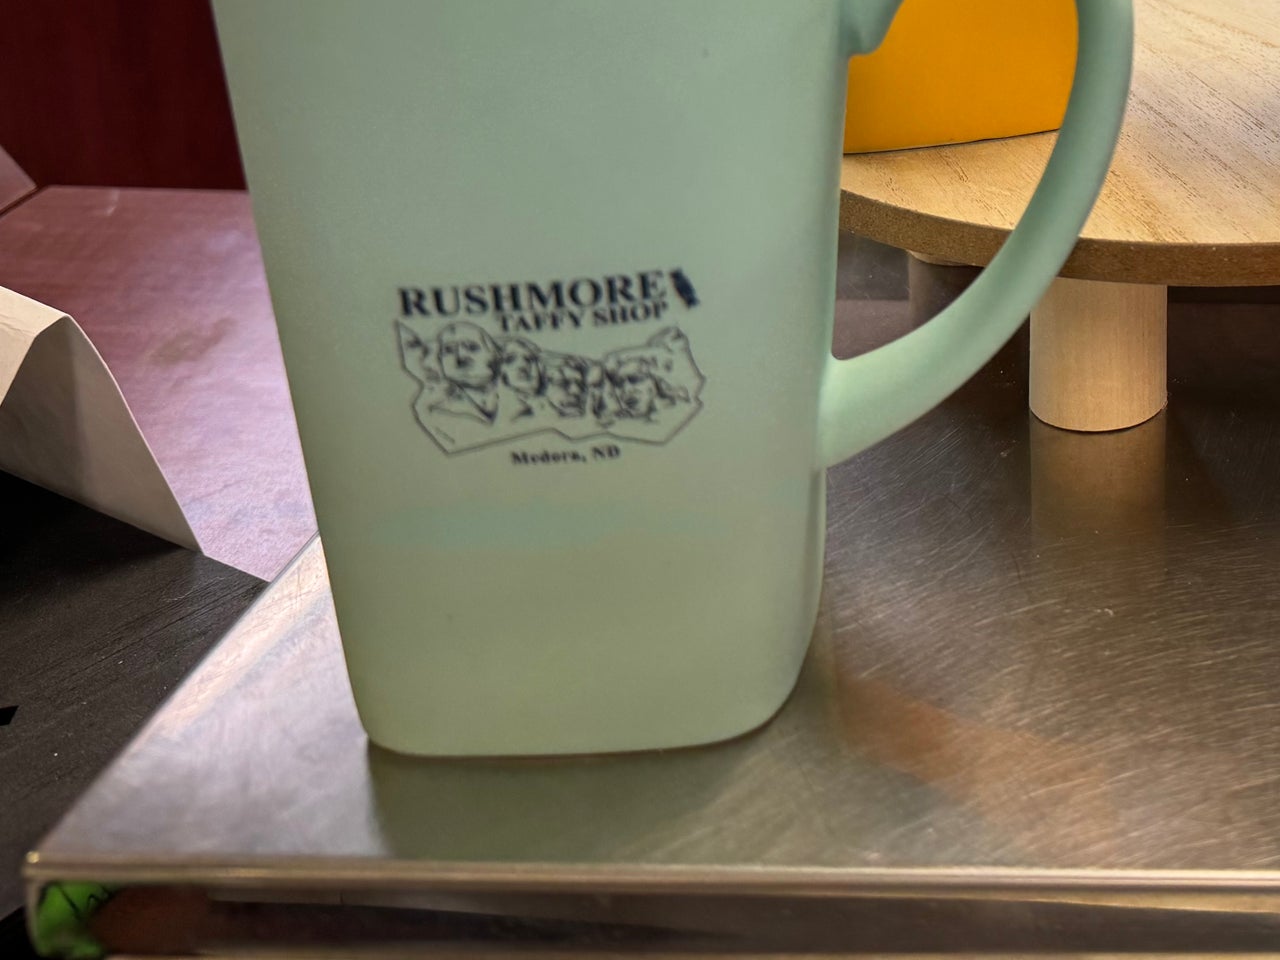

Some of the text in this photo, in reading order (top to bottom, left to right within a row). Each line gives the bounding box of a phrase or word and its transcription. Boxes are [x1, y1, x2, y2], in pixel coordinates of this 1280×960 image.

[397, 270, 669, 317] RUSHMORE
[499, 299, 669, 333] TAFFY SHOP
[511, 445, 621, 465] Medora, ND
